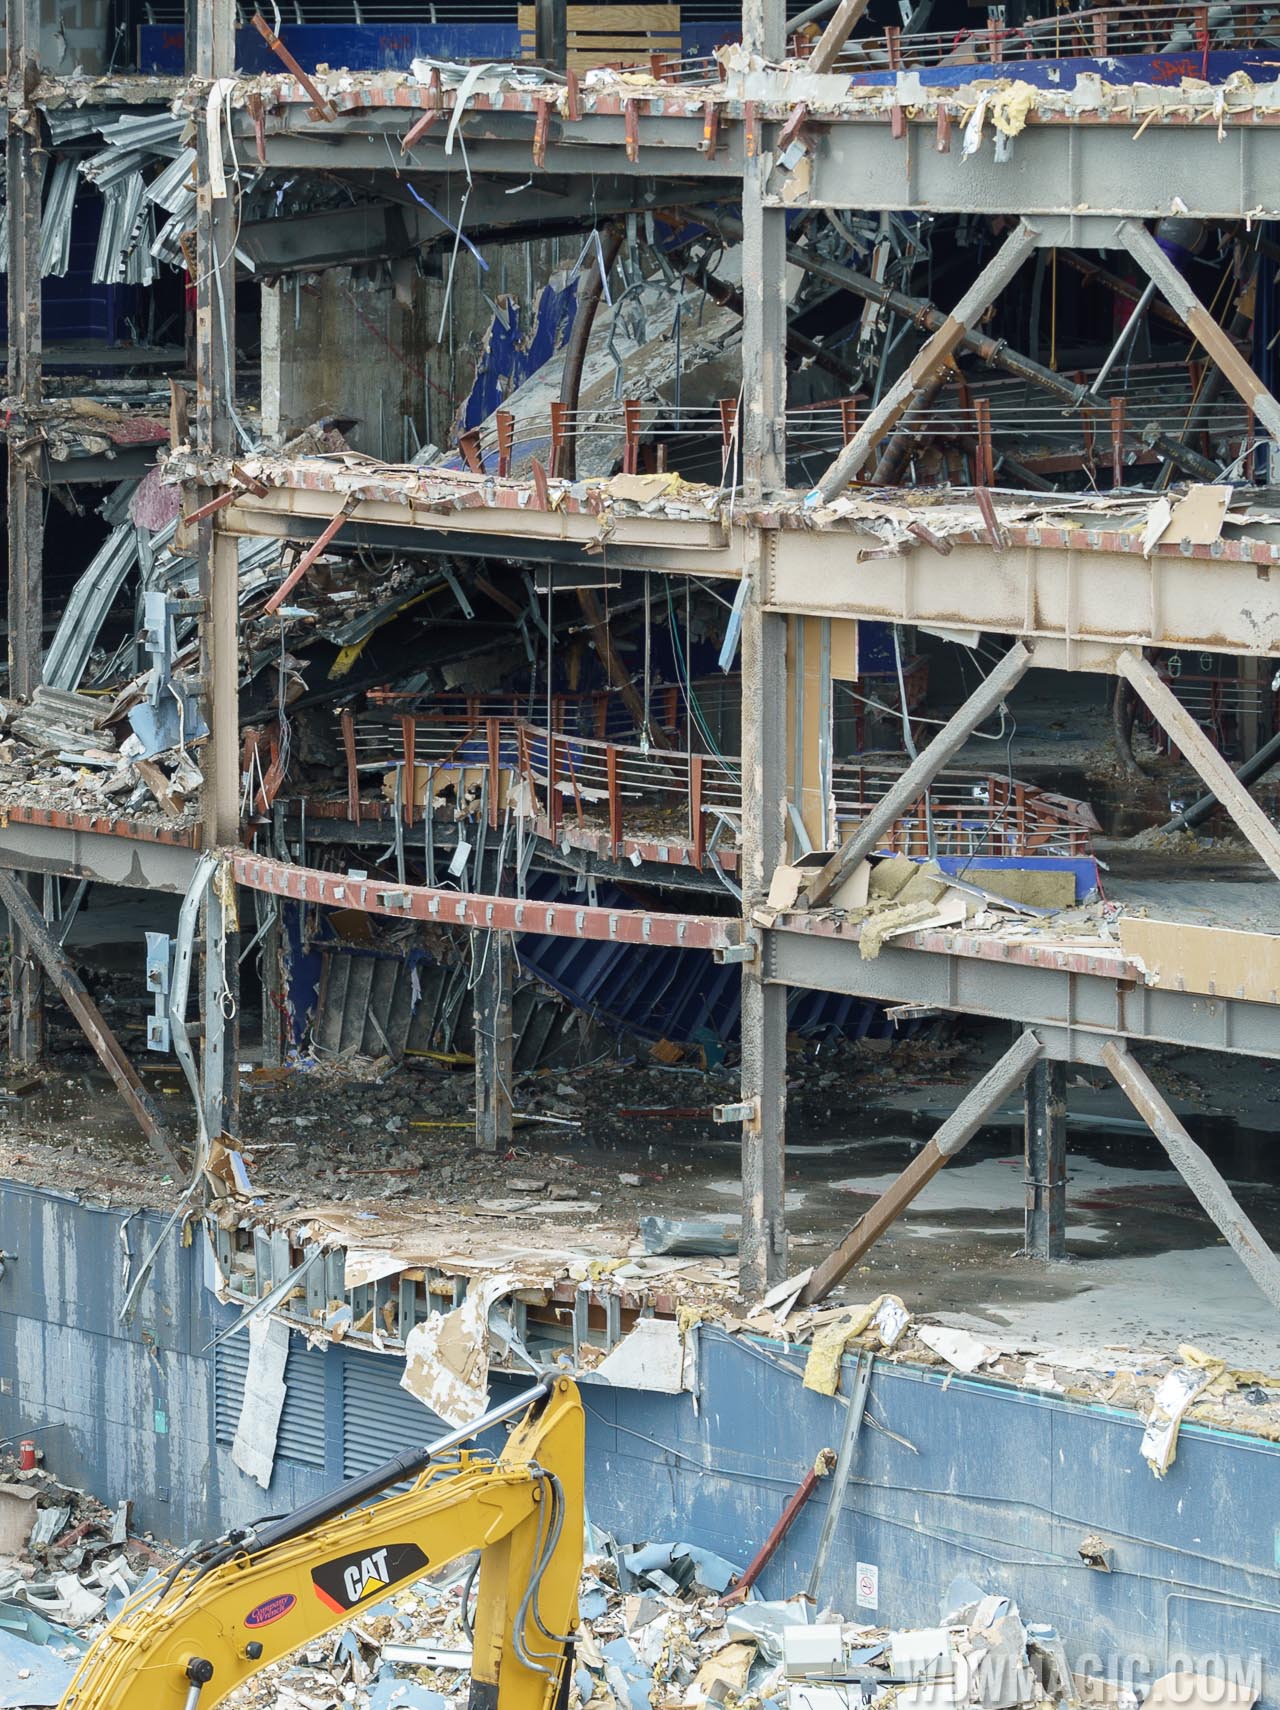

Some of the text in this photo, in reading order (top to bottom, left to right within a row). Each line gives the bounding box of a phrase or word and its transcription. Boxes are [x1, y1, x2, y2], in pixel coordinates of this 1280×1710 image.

[343, 1548, 389, 1601] CAT
[252, 1597, 289, 1618] Company
[256, 1604, 286, 1623] Wrench
